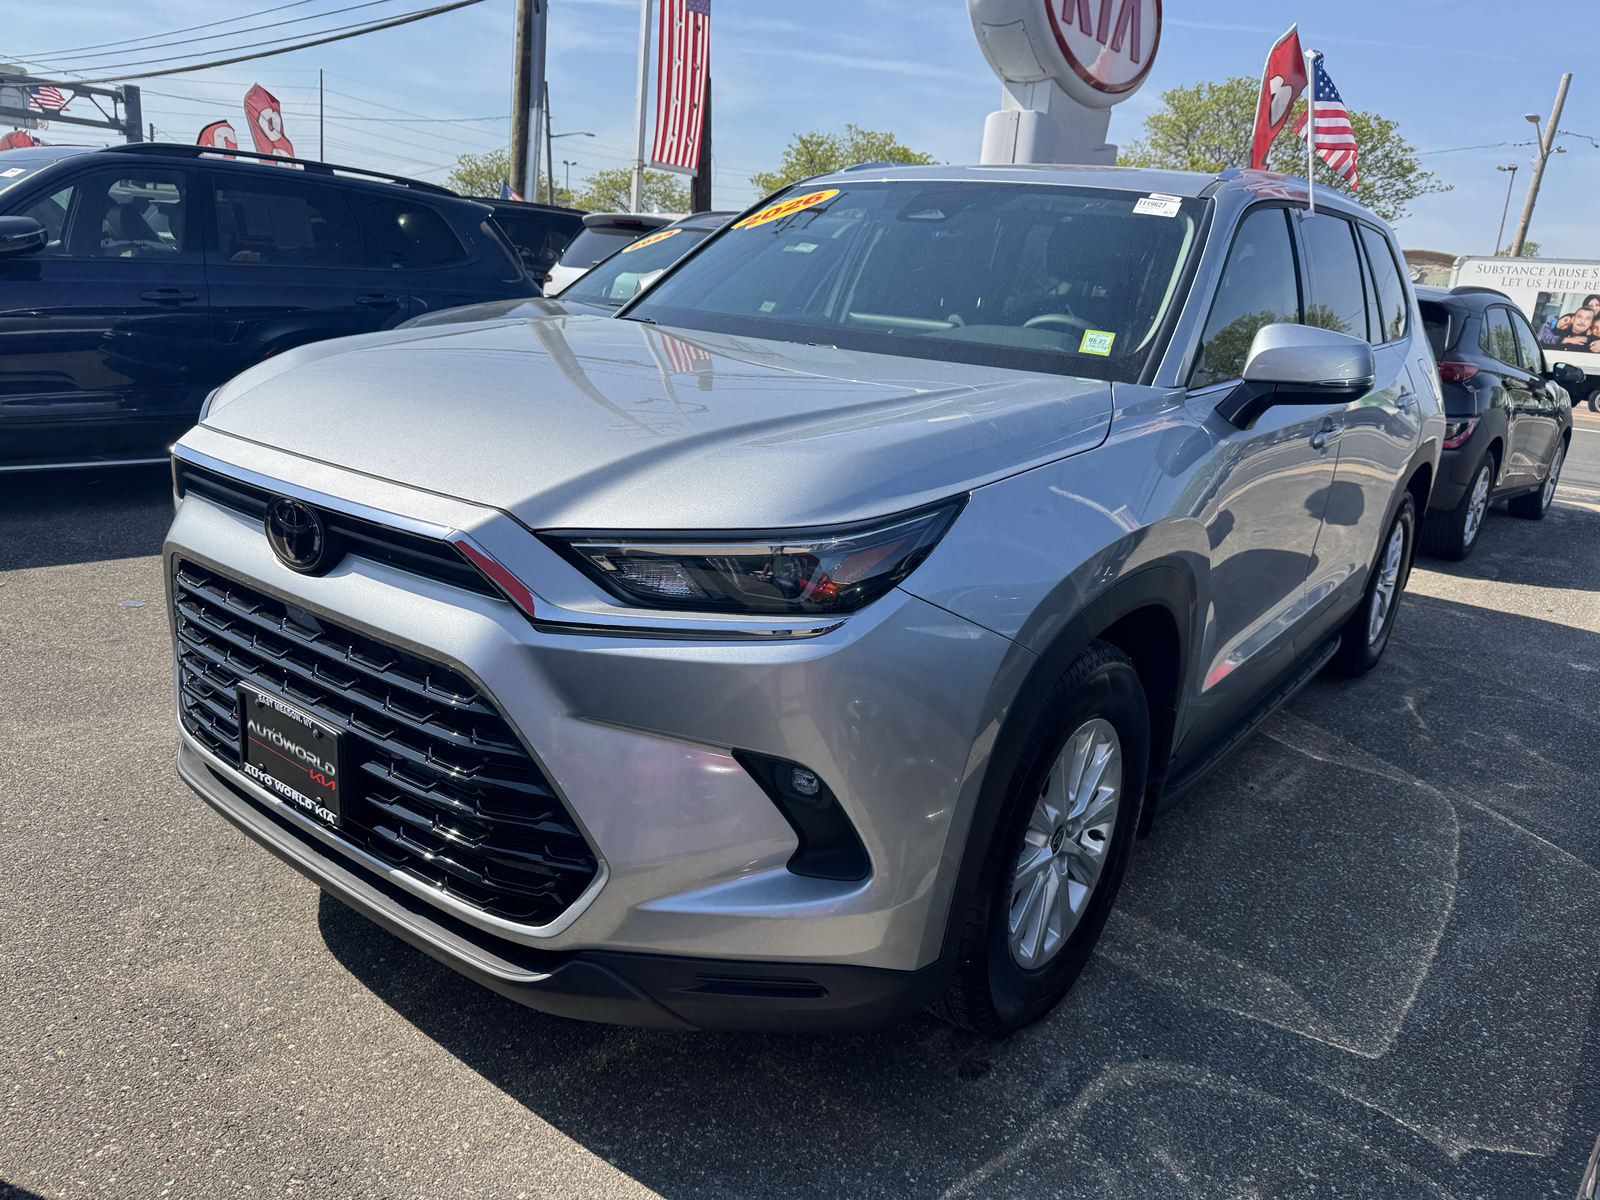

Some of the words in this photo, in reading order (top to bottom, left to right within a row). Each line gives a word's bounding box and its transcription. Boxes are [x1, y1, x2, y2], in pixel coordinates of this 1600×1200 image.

[744, 192, 826, 226] 2026
[1476, 263, 1545, 277] SUBSTANCE
[1548, 267, 1589, 278] ABUSE
[1501, 276, 1523, 287] LET
[1526, 279, 1542, 288] US
[1546, 278, 1580, 290] HELP
[257, 694, 274, 709] EAST
[302, 716, 314, 730] NY
[244, 762, 273, 786] AUTO
[274, 783, 313, 810] WORLD
[315, 803, 338, 824] KIA
